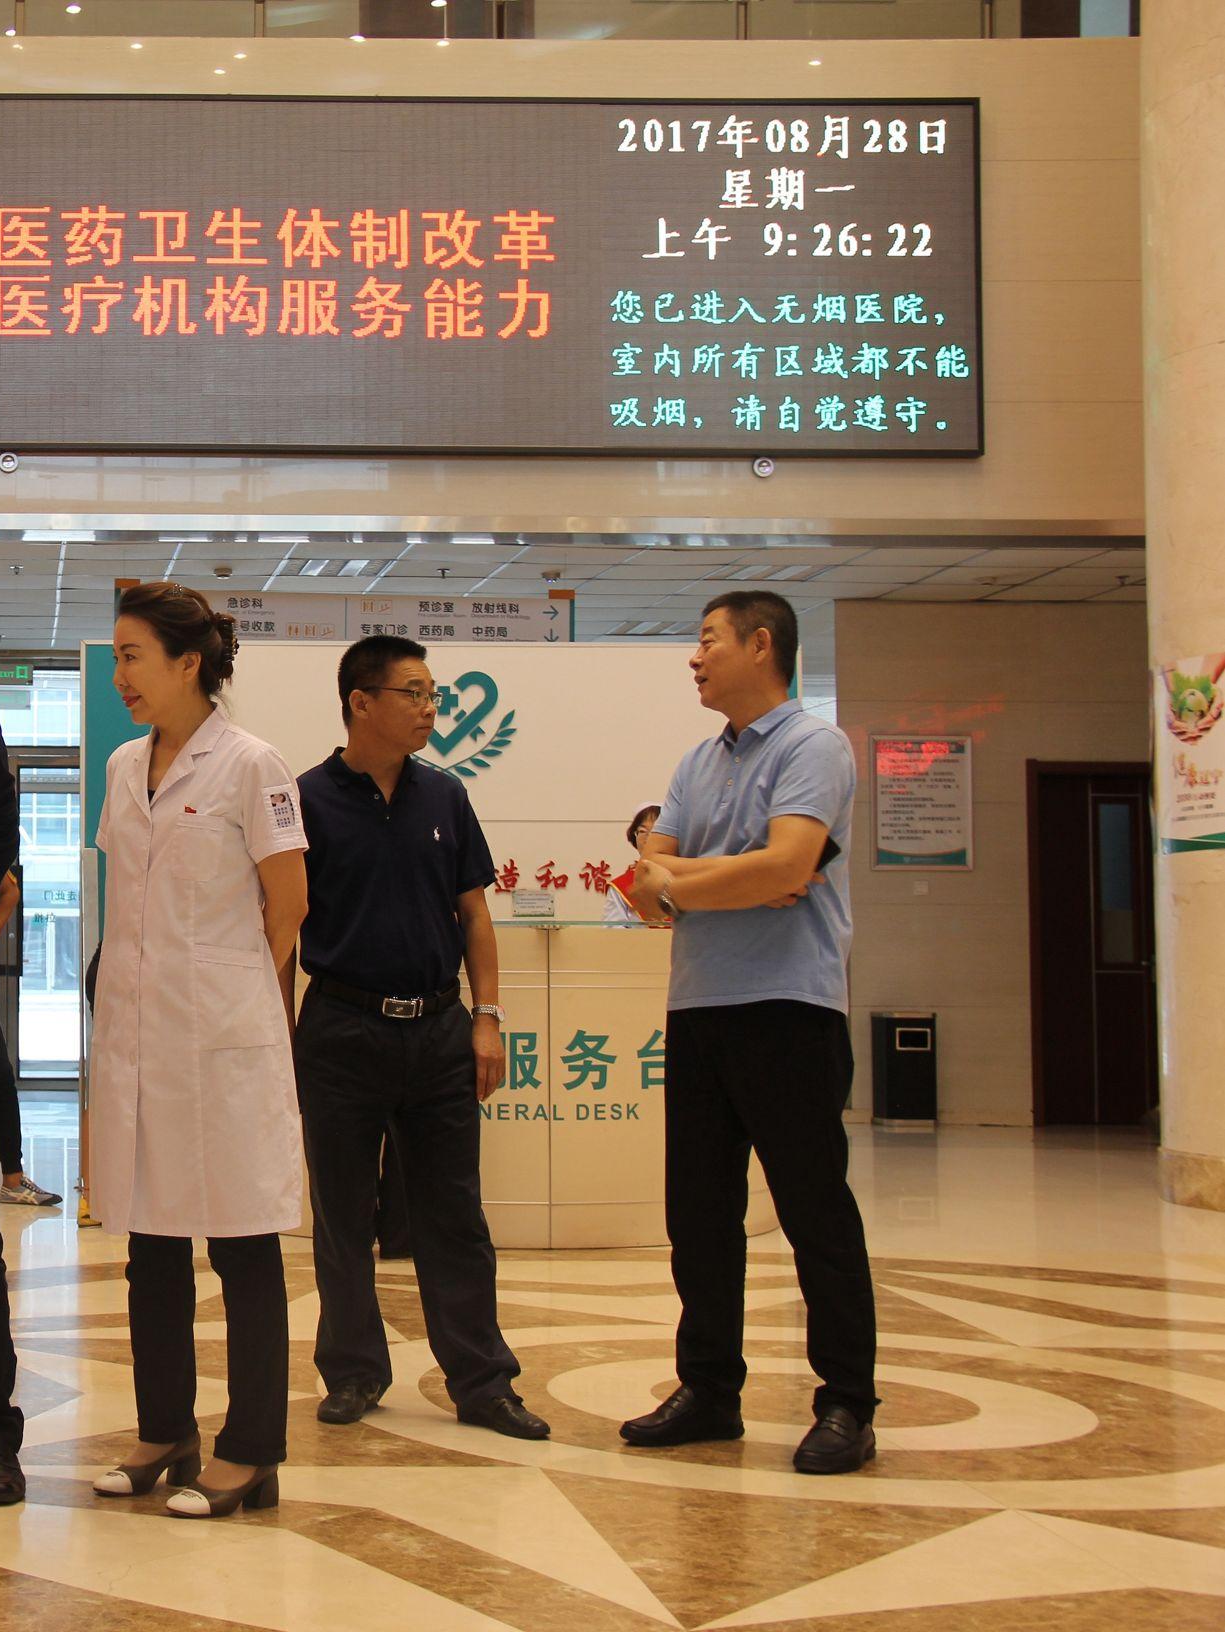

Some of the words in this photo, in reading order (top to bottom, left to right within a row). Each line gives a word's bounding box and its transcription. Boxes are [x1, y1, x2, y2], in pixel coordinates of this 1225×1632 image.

[617, 115, 947, 159] 2017年08月28日
[719, 167, 855, 210] 星期一
[643, 217, 732, 260] 上午
[611, 342, 970, 381] 室内所有区域都不能
[227, 597, 263, 609] 急诊科
[418, 601, 454, 613] 预诊室
[471, 602, 519, 615] 放射线科
[361, 623, 408, 636] 专家门诊
[418, 624, 455, 637] 西药局
[472, 626, 508, 638] 中药局
[496, 1029, 666, 1091] 服务台
[576, 1102, 640, 1121] DESK
